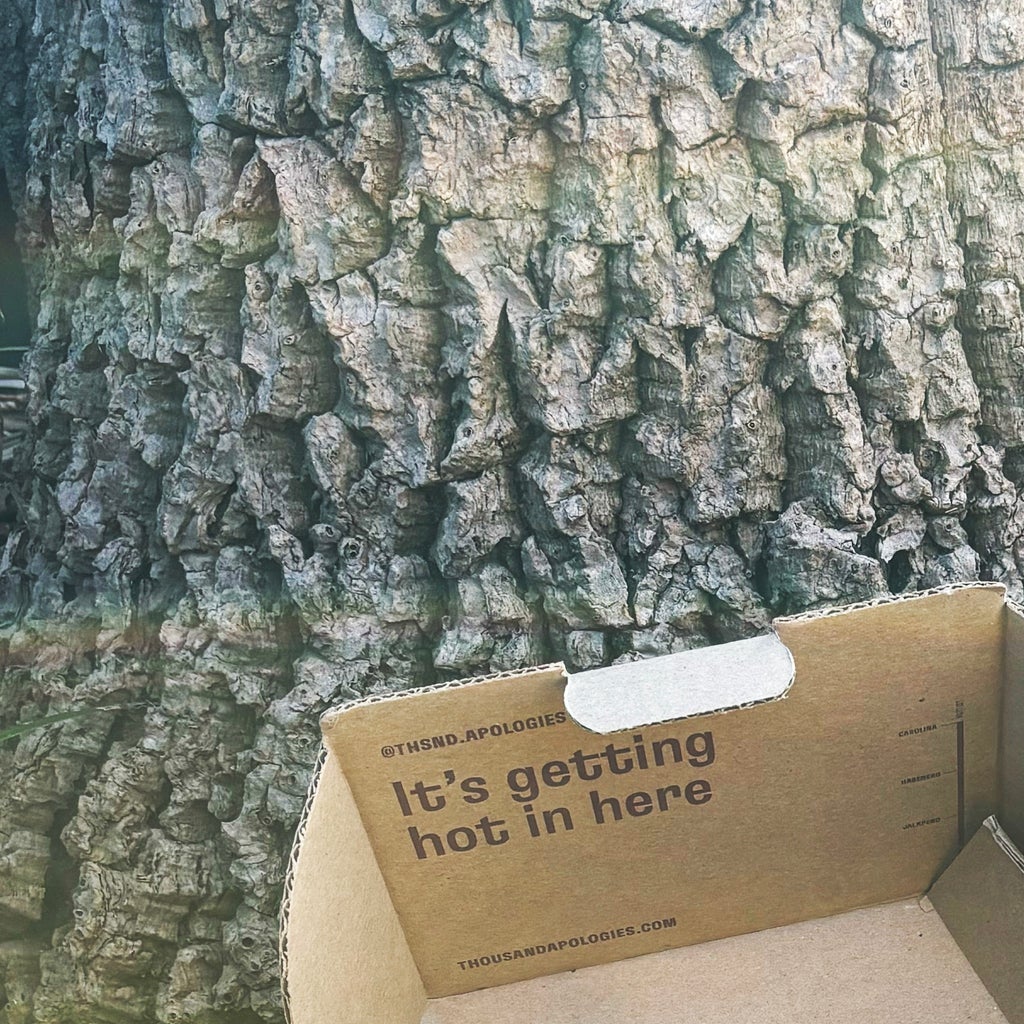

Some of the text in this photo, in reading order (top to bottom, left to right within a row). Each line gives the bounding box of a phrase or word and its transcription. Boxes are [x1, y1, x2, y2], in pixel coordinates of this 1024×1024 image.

[381, 711, 566, 758] @THSND.APOLOGIES
[898, 724, 938, 737] CAROLINA
[392, 731, 716, 816] It's getting
[408, 779, 713, 860] hot in here
[457, 917, 677, 971] THOUSANDAPOLOGIES.COM
